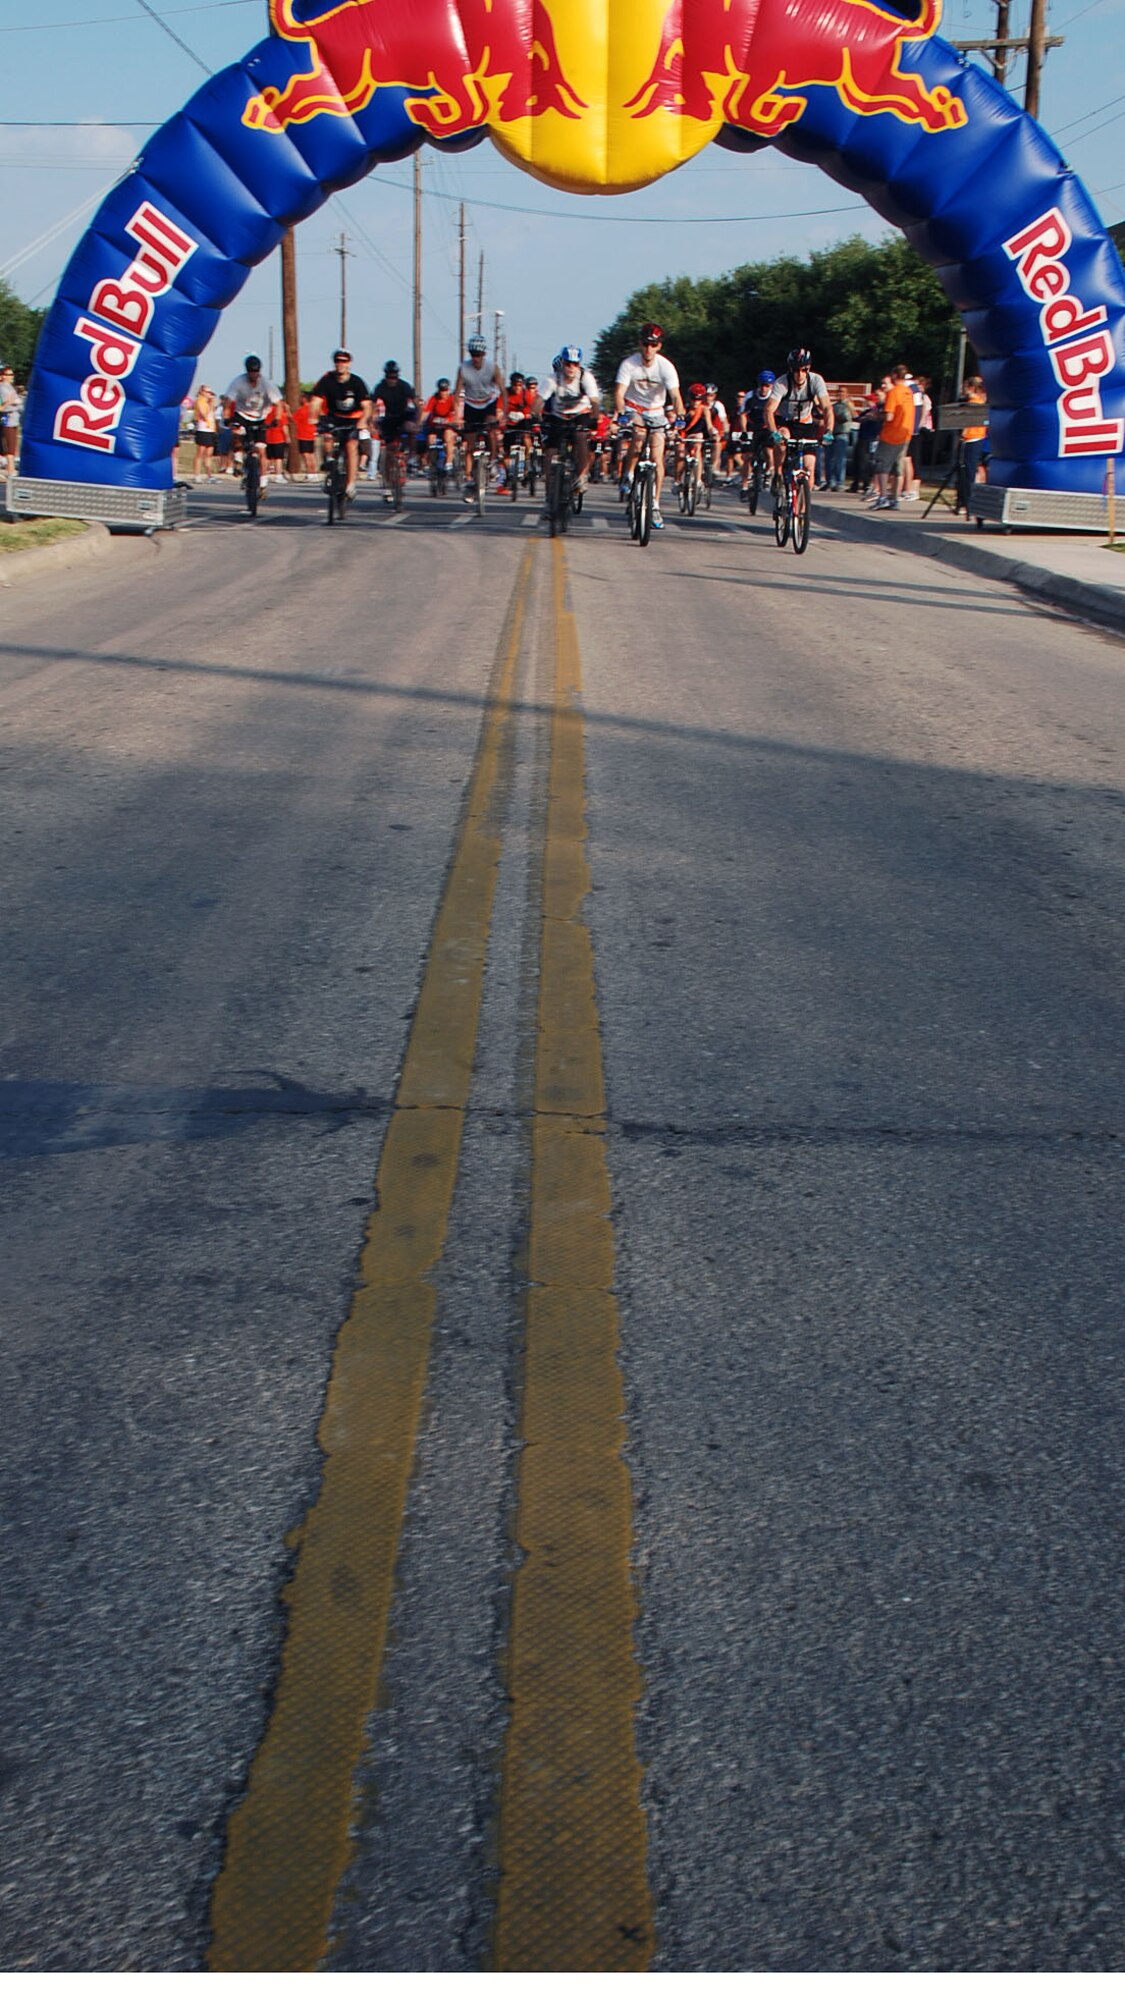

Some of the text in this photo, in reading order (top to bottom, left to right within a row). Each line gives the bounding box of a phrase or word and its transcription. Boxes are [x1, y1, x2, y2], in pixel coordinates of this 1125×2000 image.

[56, 203, 197, 453] Red Bull
[1004, 209, 1124, 457] Red Bull
